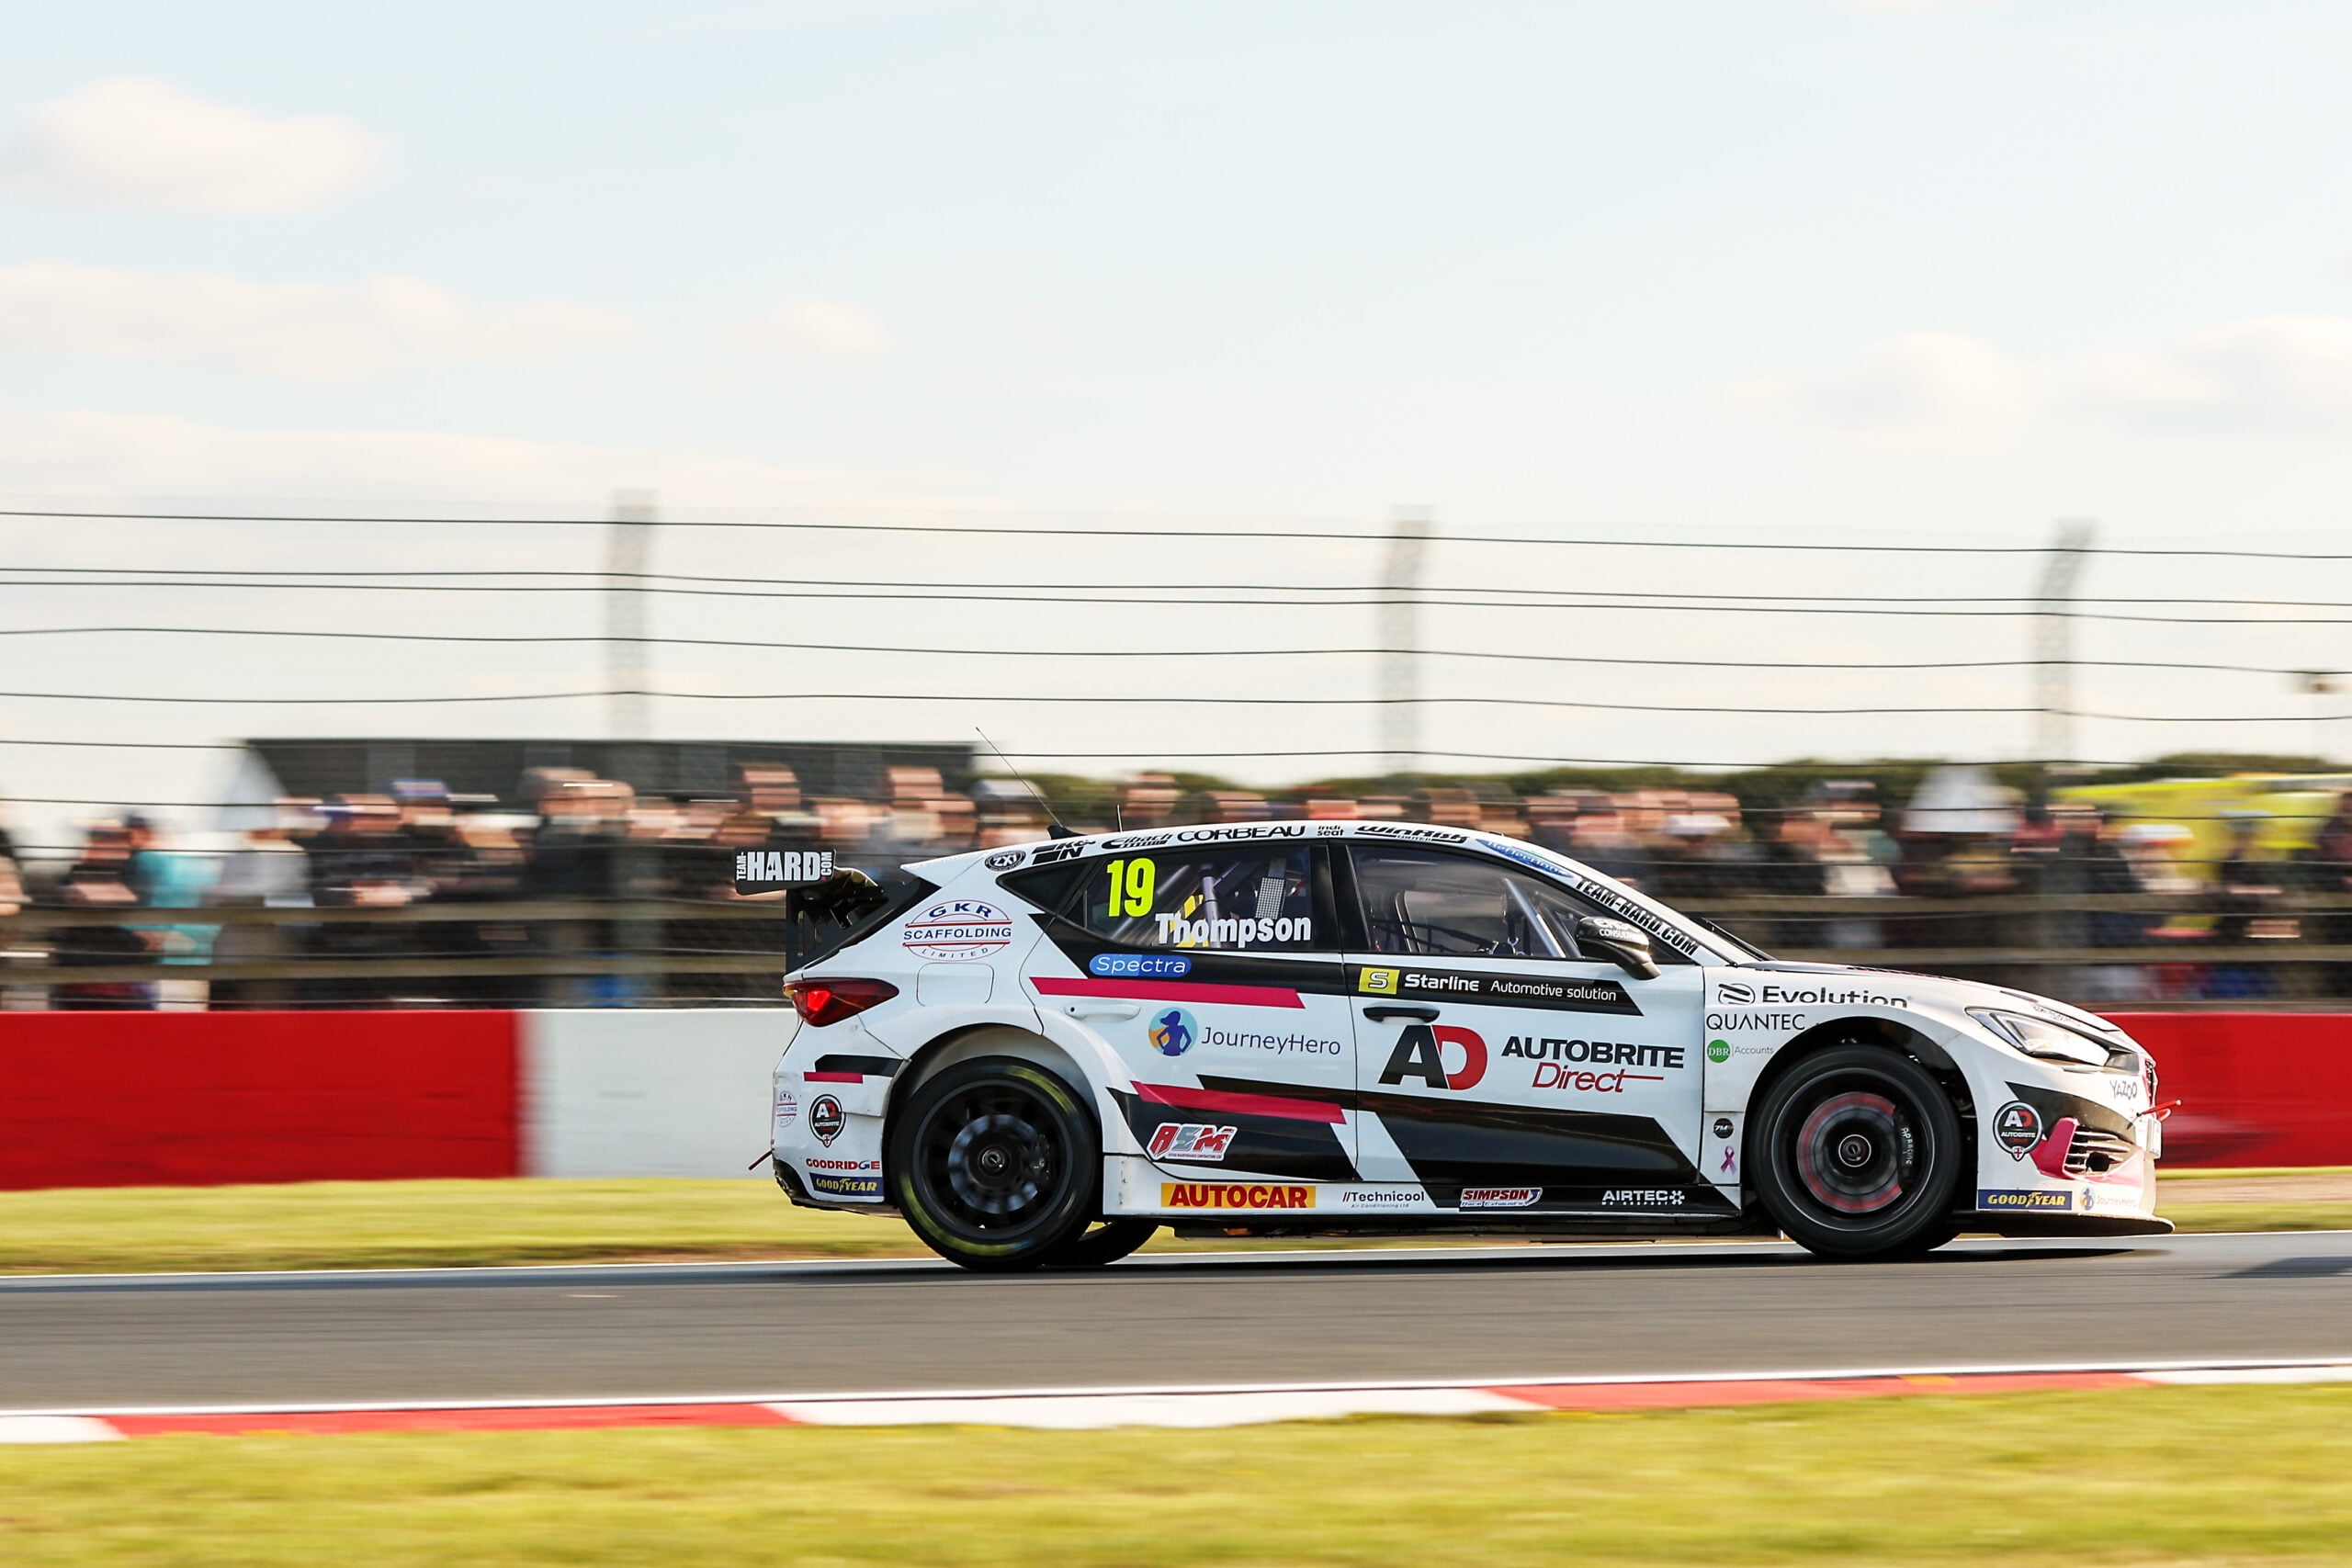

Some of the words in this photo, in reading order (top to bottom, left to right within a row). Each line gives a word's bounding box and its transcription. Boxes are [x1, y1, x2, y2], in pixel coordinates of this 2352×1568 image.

[1177, 826, 1306, 841] CORBEAU
[747, 852, 820, 881] HARD
[992, 854, 1018, 866] ZX1
[1106, 858, 1155, 917] 19
[929, 903, 991, 918] GKR
[1575, 878, 1699, 956] TEAM-HARD.COM
[904, 927, 1012, 940] SCAFFOLDING
[1155, 912, 1311, 949] Thompson
[922, 947, 989, 958] LIMITED
[1096, 957, 1186, 975] Spectra
[1404, 973, 1480, 992] Starline
[1490, 980, 1563, 998] Automotive
[1566, 987, 1617, 1002] solution
[1762, 986, 1908, 1008] Evolution
[1706, 1013, 1805, 1031] QUANTEC
[1202, 1027, 1341, 1055] JourneyHero
[1501, 1035, 1685, 1069] AUTOBRITE
[1708, 1046, 1731, 1056] DBR
[1735, 1045, 1774, 1055] Accounts
[1532, 1062, 1664, 1093] Direct
[806, 1158, 880, 1170] GOODRIDGE
[1170, 1185, 1307, 1209] AUTOCAR
[1463, 1190, 1530, 1201] SIMPSON
[1601, 1190, 1668, 1201] AIRTEC
